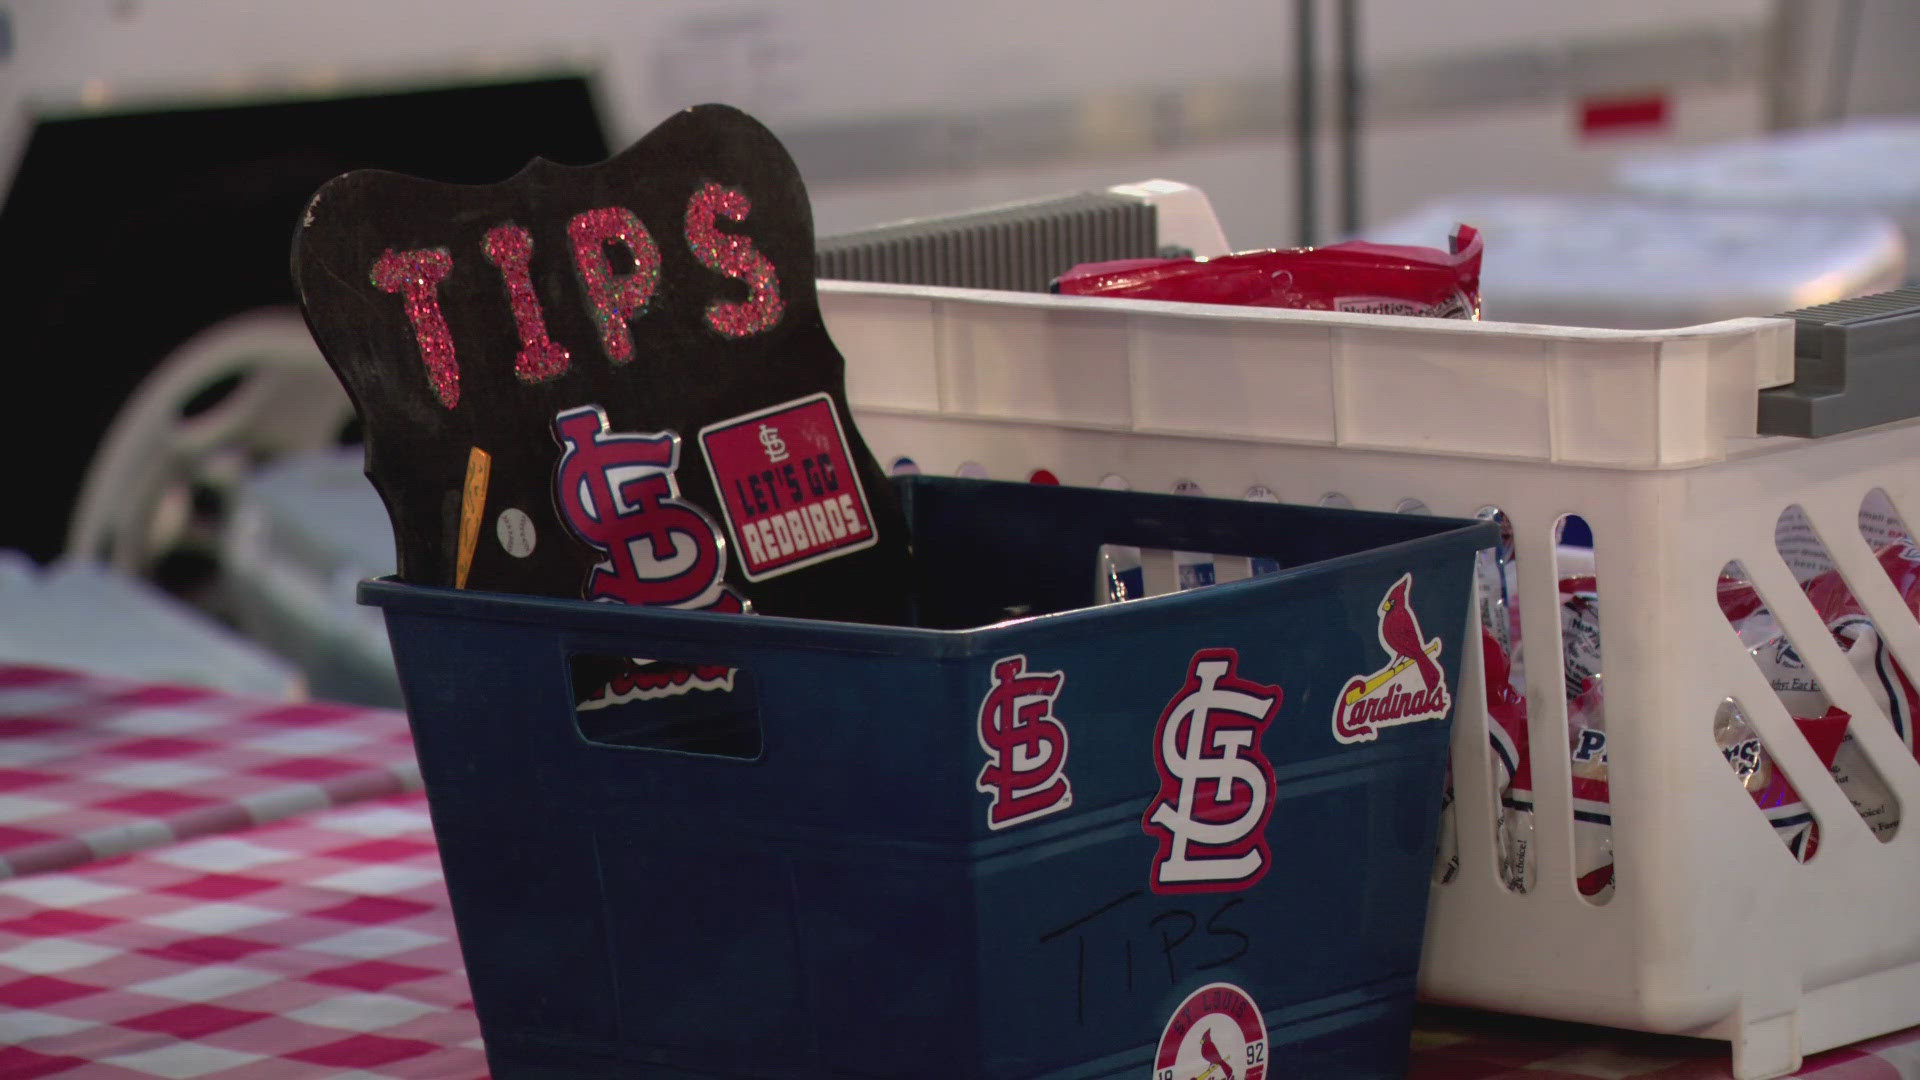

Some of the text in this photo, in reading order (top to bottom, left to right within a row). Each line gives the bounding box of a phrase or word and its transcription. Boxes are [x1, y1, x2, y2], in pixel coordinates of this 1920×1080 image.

[370, 181, 786, 411] TIPS
[735, 453, 839, 518] LET'S GO
[742, 493, 861, 565] REDBIRDS
[1336, 680, 1446, 737] Cardinals
[1040, 890, 1251, 1027] TIPS
[1202, 991, 1248, 1019] LOUIS
[1246, 1042, 1264, 1065] 92
